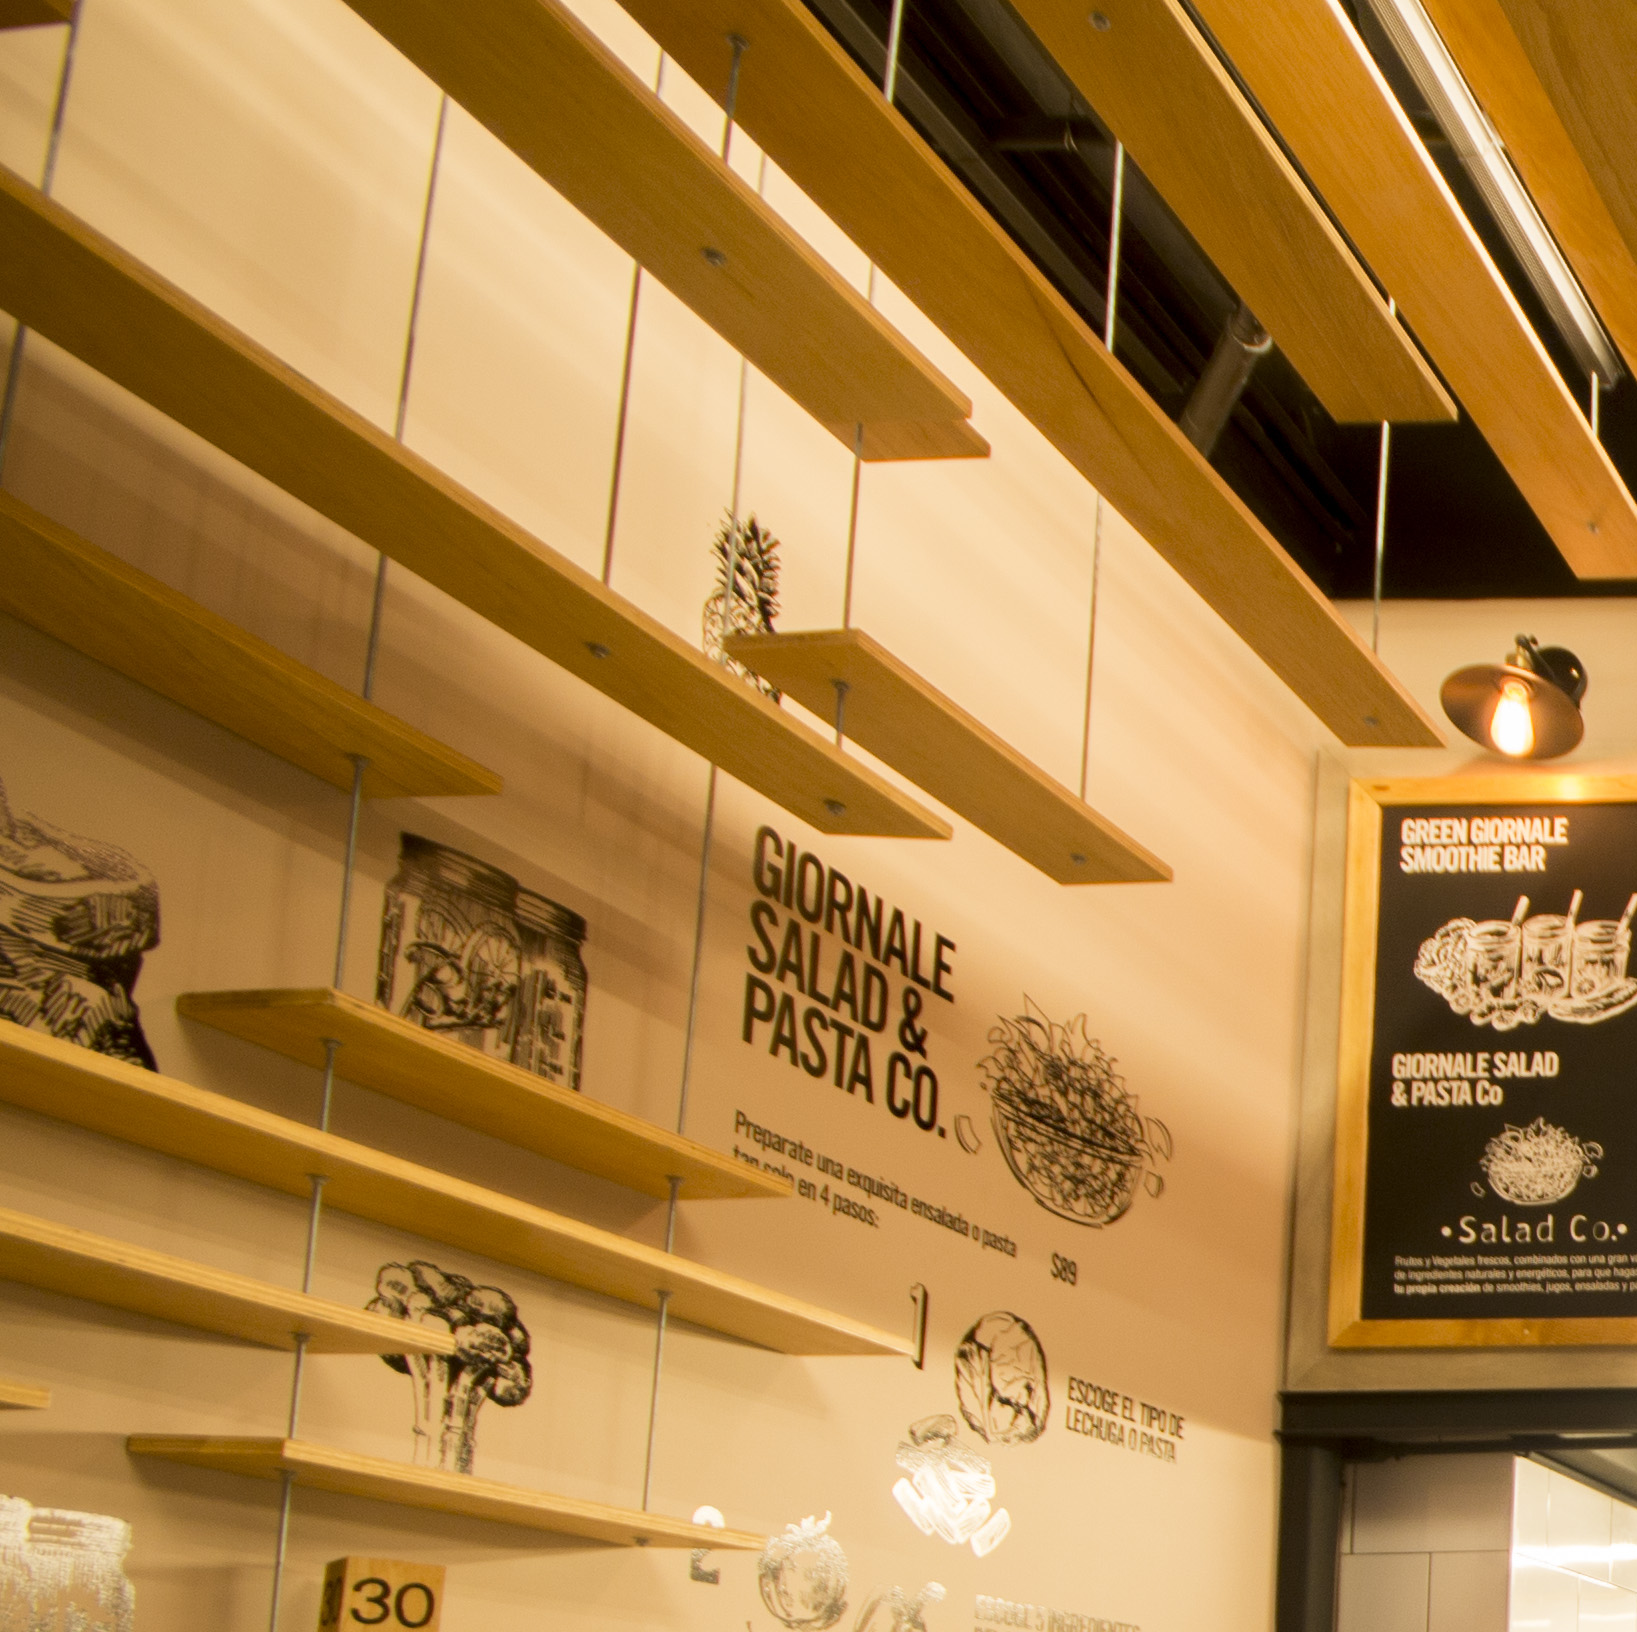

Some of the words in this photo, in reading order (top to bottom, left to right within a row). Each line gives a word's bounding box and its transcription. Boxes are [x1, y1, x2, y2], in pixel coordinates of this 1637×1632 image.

[1401, 817, 1468, 845] GREEN
[1470, 816, 1568, 845] GIORNALE
[1400, 846, 1500, 873] SMOOTHIE
[1503, 846, 1546, 871] BAR
[753, 825, 956, 1003] GIORNALE
[746, 900, 888, 1033] SALAD
[898, 986, 928, 1061] &
[742, 973, 874, 1105] PASTA
[886, 1052, 946, 1138] CO.
[1392, 1053, 1489, 1080] GIORNALE
[1493, 1052, 1559, 1077] SALAD
[1392, 1081, 1408, 1108] &
[1410, 1080, 1474, 1106] PASTA
[1476, 1081, 1502, 1105] Co
[734, 1110, 813, 1166] Preparate
[816, 1154, 843, 1180] una
[847, 1165, 908, 1209] exquisita
[911, 1198, 968, 1238] ensalada
[971, 1225, 979, 1240] o
[982, 1226, 1017, 1258] pasta
[799, 1179, 816, 1201] en
[820, 1184, 829, 1206] 4
[833, 1194, 879, 1228] pasos:
[1459, 1214, 1553, 1243] Salad
[1068, 1376, 1119, 1416] ESCOGE
[1122, 1396, 1135, 1422] EL
[1140, 1402, 1166, 1433] TIPO
[1170, 1416, 1185, 1439] DE
[1066, 1406, 1125, 1449] LECHUGA
[1128, 1434, 1137, 1451] O
[1140, 1435, 1176, 1464] PASTA
[351, 1578, 435, 1629] 30
